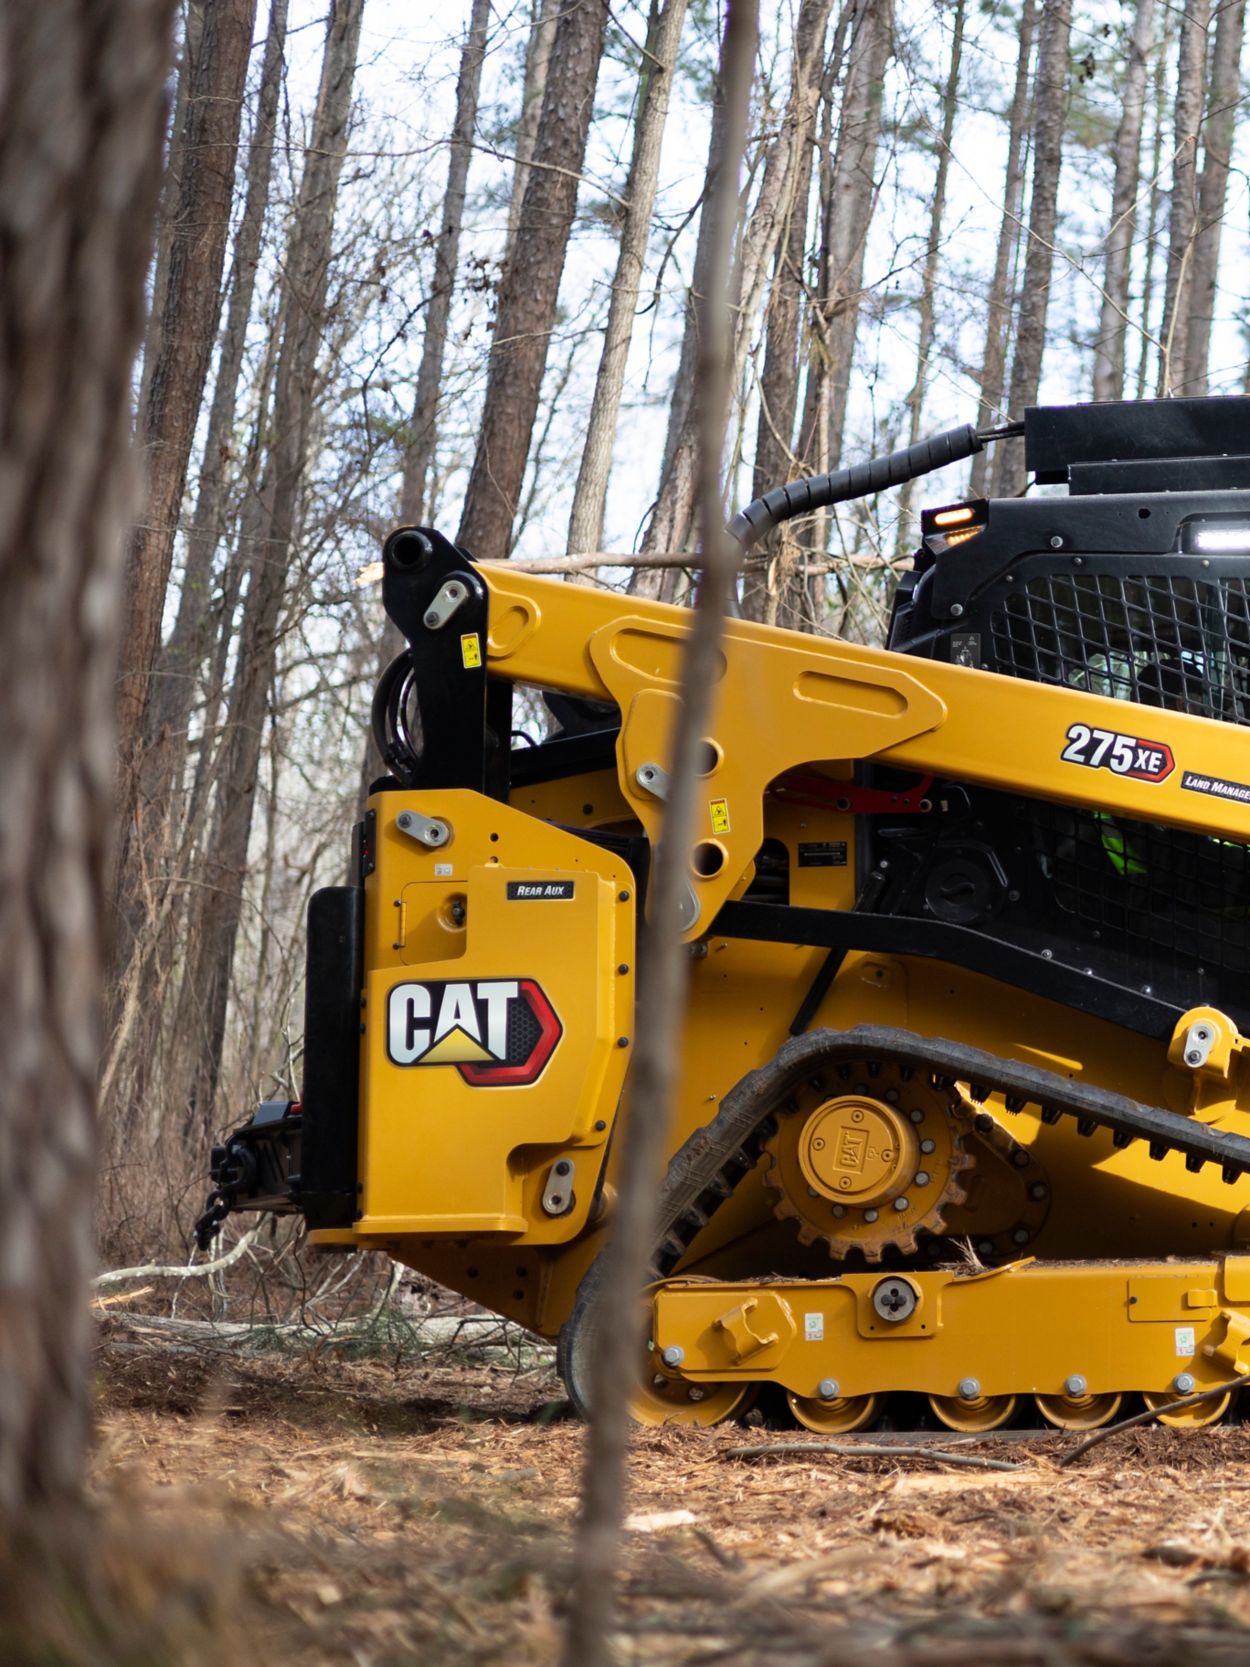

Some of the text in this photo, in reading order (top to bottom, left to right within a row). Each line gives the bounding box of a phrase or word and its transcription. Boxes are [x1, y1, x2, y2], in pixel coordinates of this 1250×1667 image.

[1062, 724, 1163, 774] 275XE
[1184, 775, 1210, 790] LAND
[516, 885, 565, 896] REAR AUX
[389, 981, 519, 1064] CAT
[839, 1130, 863, 1168] CAT
